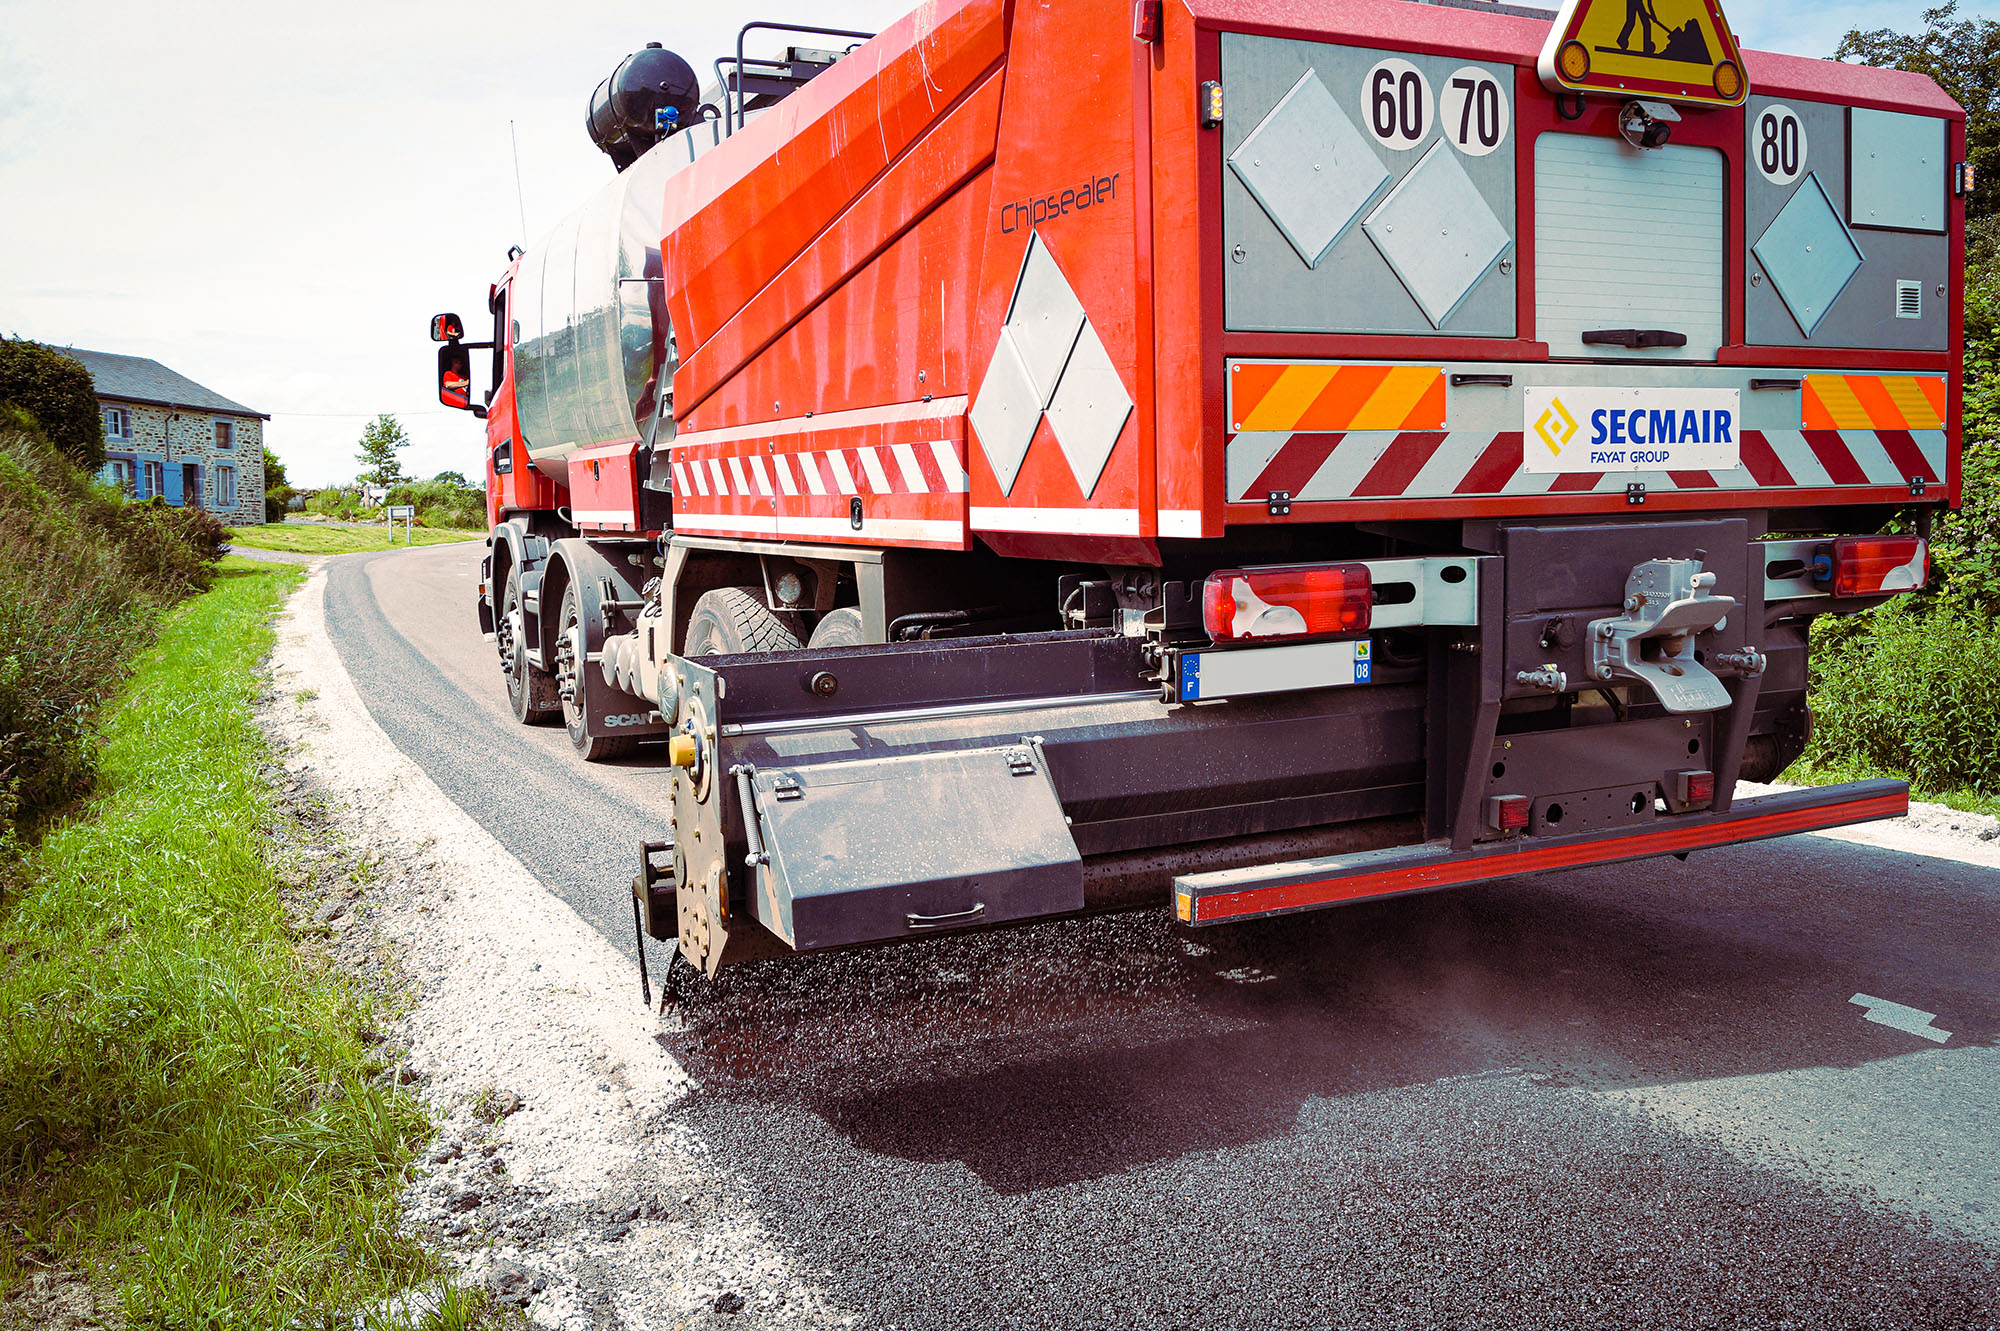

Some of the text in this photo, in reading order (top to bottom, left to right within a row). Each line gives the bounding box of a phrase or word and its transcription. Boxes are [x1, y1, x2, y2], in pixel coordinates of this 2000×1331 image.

[1372, 68, 1423, 140] 60
[1452, 78, 1499, 147] 70
[1761, 113, 1799, 176] 80
[1001, 173, 1119, 233] Chipsealer
[1590, 409, 1733, 444] SECMAIR
[1590, 450, 1670, 464] FAYAT GROUP
[1187, 681, 1194, 692] F
[1356, 663, 1368, 679] 08
